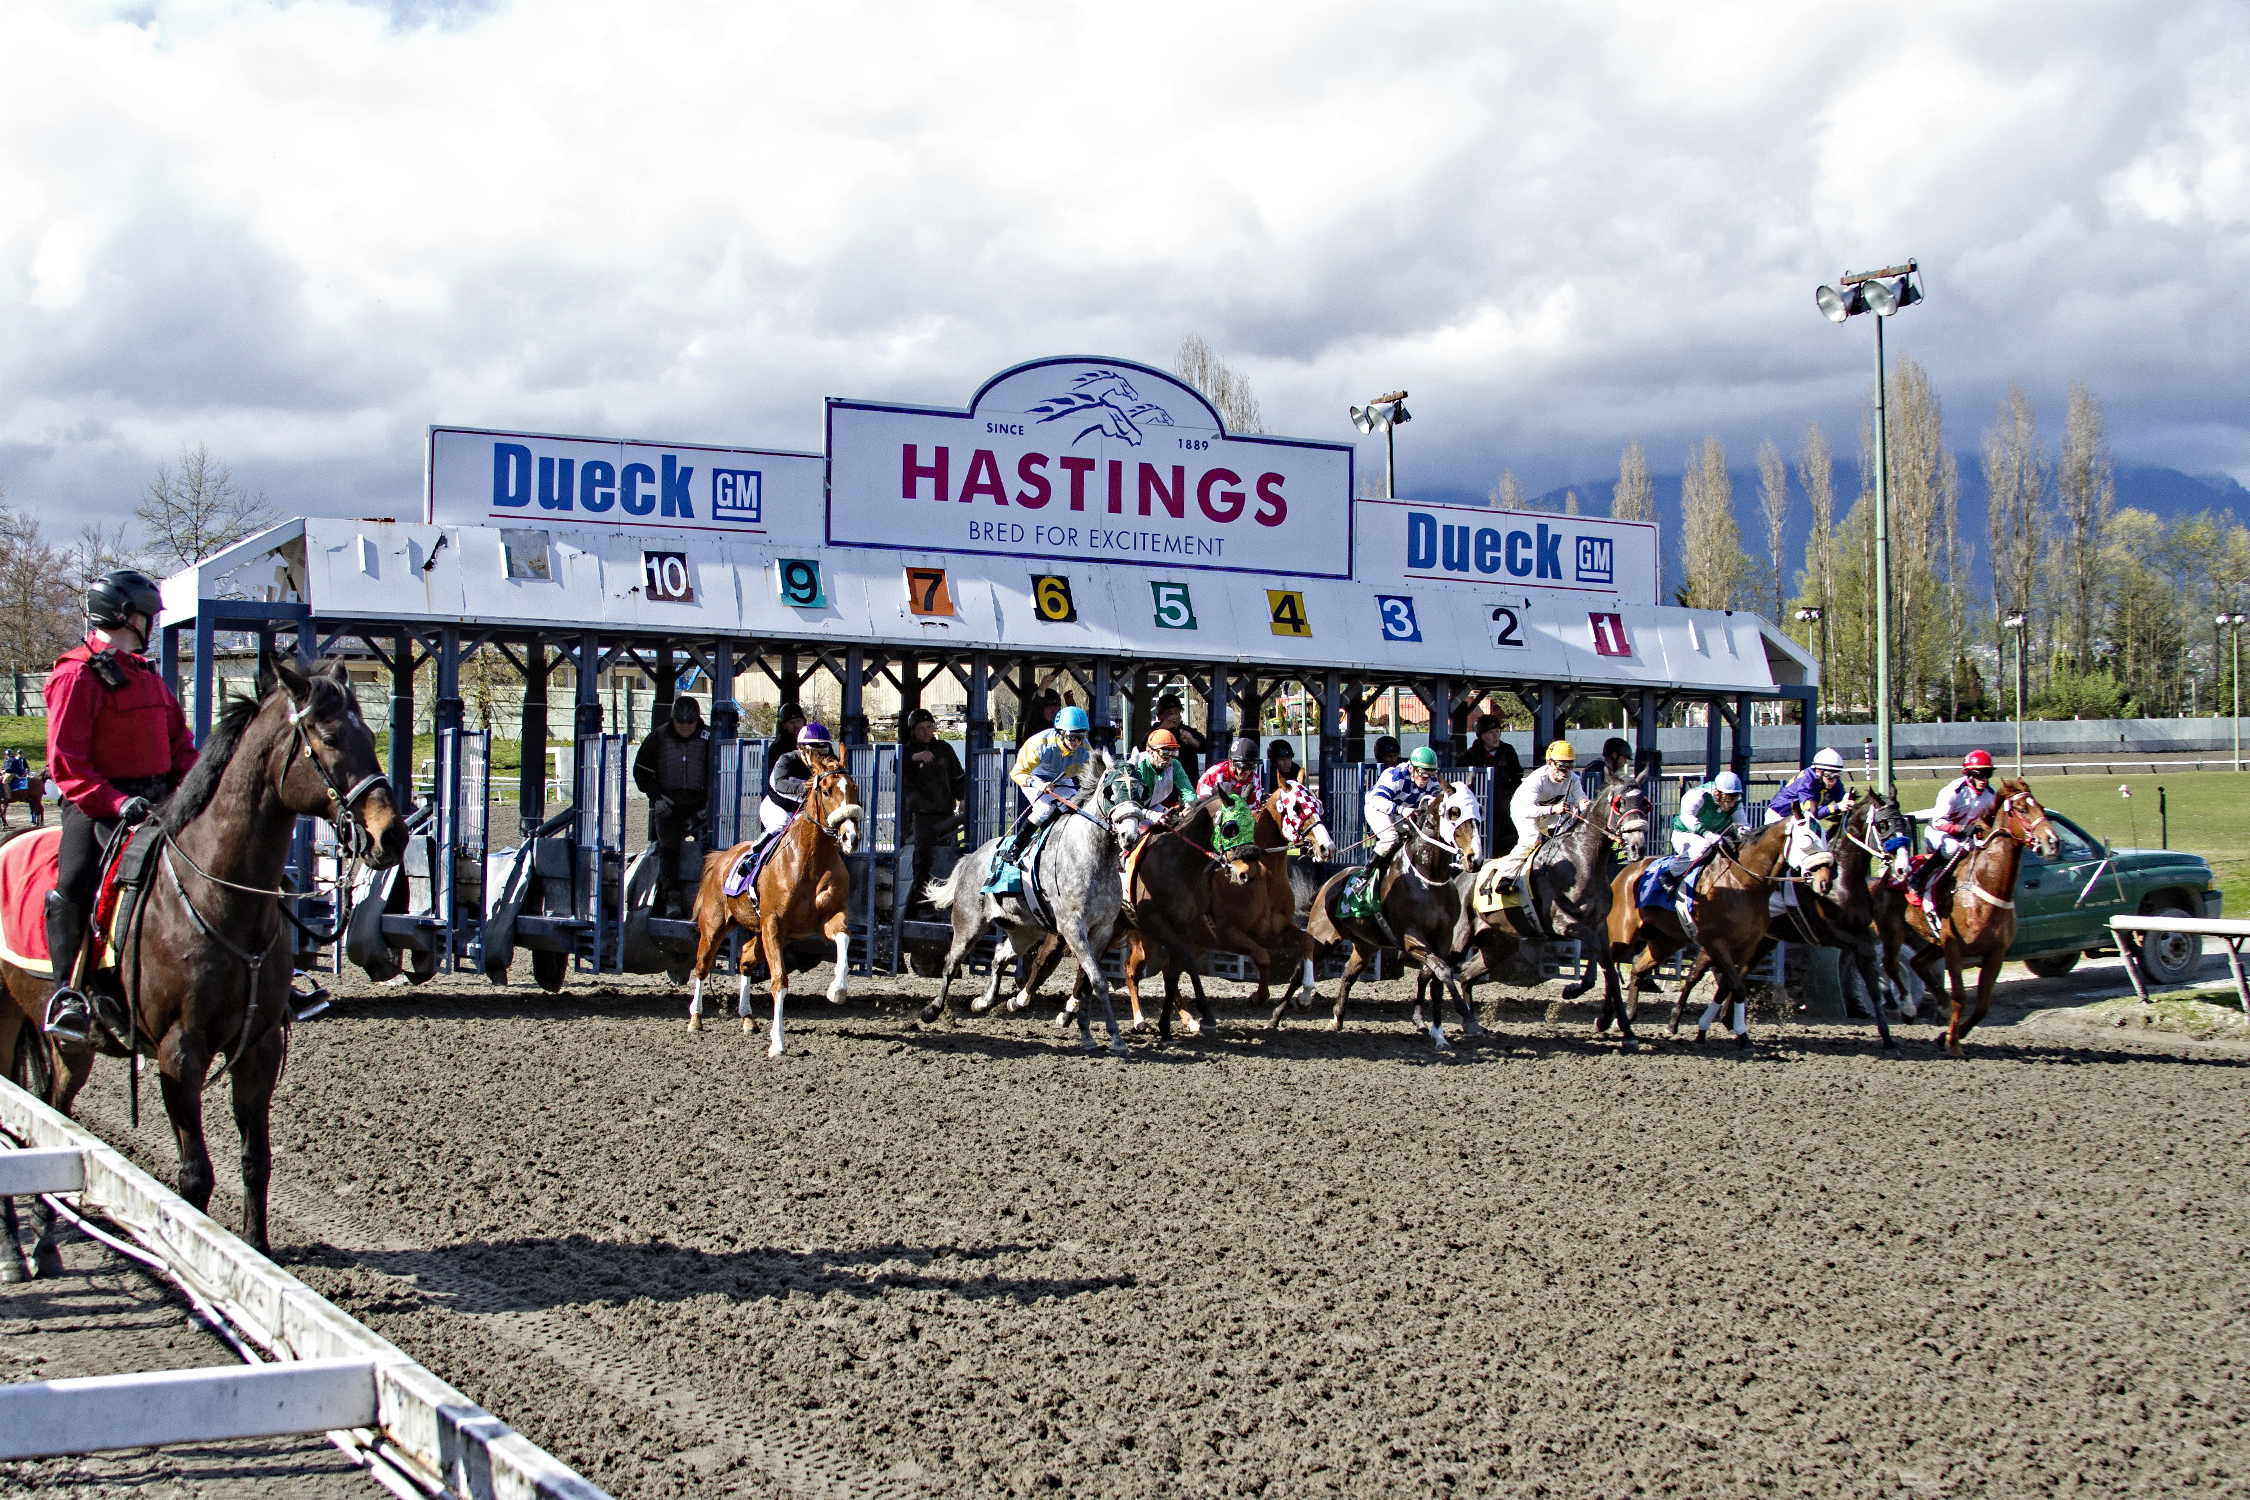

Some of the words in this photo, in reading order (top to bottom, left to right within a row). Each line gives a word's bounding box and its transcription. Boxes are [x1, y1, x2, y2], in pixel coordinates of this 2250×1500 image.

[986, 423, 1025, 436] SINCE
[1178, 438, 1210, 452] 1889
[493, 442, 695, 519] Dueck
[716, 472, 759, 509] GM
[902, 443, 1288, 528] HASTINGS
[970, 520, 1025, 544] BRED
[1036, 526, 1078, 548] FOR
[1090, 529, 1226, 558] EXCITEMENT
[1408, 511, 1562, 580] Dueck
[1578, 538, 1611, 571] GM
[647, 555, 687, 598] 10
[784, 561, 818, 604] 9
[912, 573, 943, 611] 7
[1037, 578, 1069, 620] 6
[1158, 587, 1190, 627] 5
[1272, 594, 1305, 633] 4
[1382, 599, 1415, 638] 3
[1492, 607, 1524, 647] 2
[1598, 615, 1619, 653] 1
[1479, 868, 1499, 906] 4
